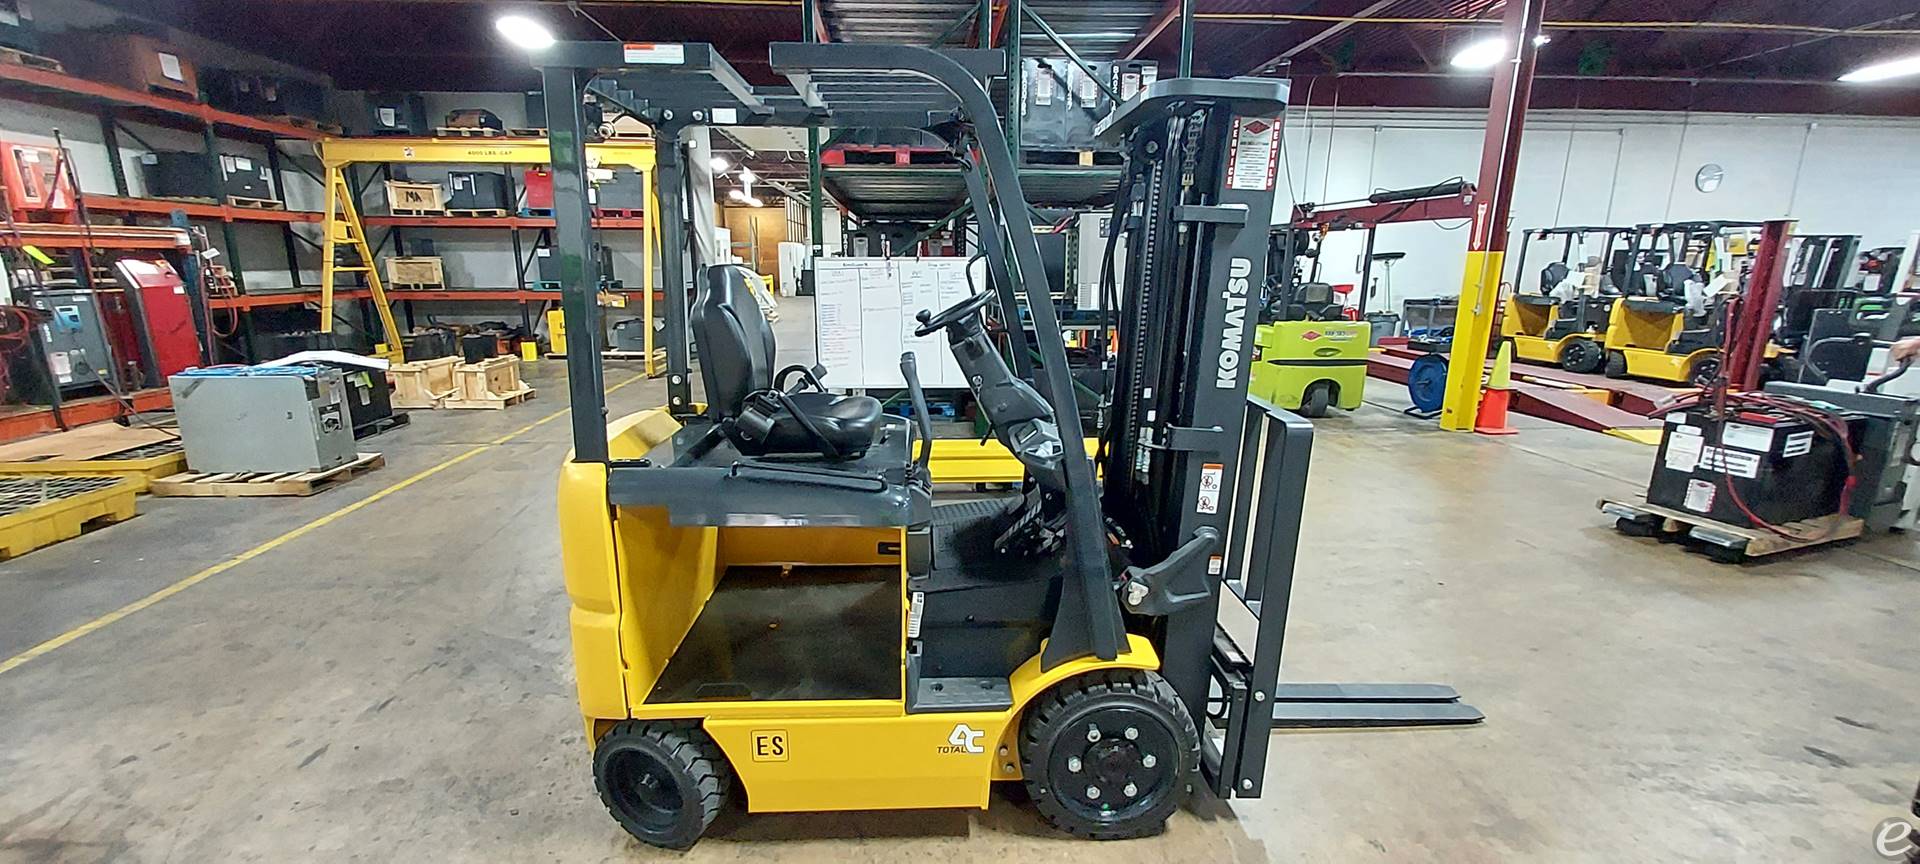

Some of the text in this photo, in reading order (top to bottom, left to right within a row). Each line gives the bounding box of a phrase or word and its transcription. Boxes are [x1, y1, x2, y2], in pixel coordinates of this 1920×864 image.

[1227, 119, 1239, 185] SERVICE
[1267, 121, 1280, 187] RENTALS
[1216, 258, 1251, 389] KOMATSU
[756, 736, 784, 756] ES
